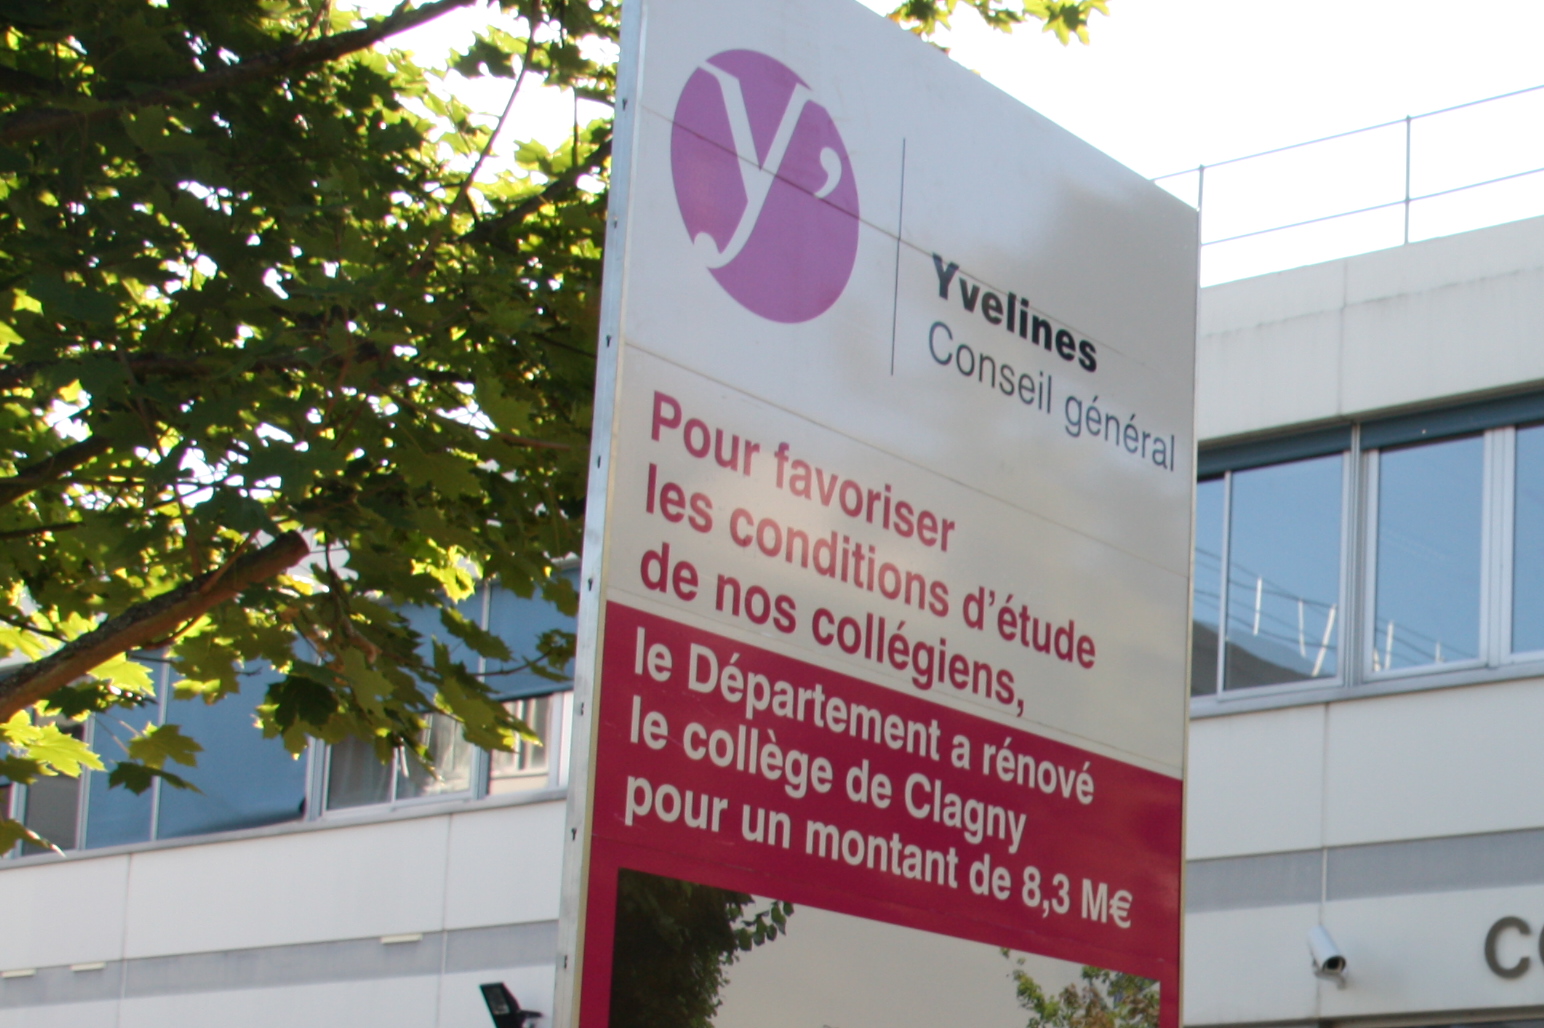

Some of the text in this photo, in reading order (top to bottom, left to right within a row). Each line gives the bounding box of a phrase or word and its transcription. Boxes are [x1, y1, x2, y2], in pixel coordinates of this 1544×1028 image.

[932, 253, 1098, 373] Yvelines
[650, 390, 955, 552] Pour favoriser
[927, 321, 1176, 472] Conseil général
[640, 542, 1025, 718] de nos collégiens,
[645, 463, 1097, 670] les conditions d'étude
[629, 695, 1027, 854] le collège de Clagny
[633, 626, 1095, 805] le Département a rénové
[624, 775, 1133, 929] pour un montant de 8,3 M€
